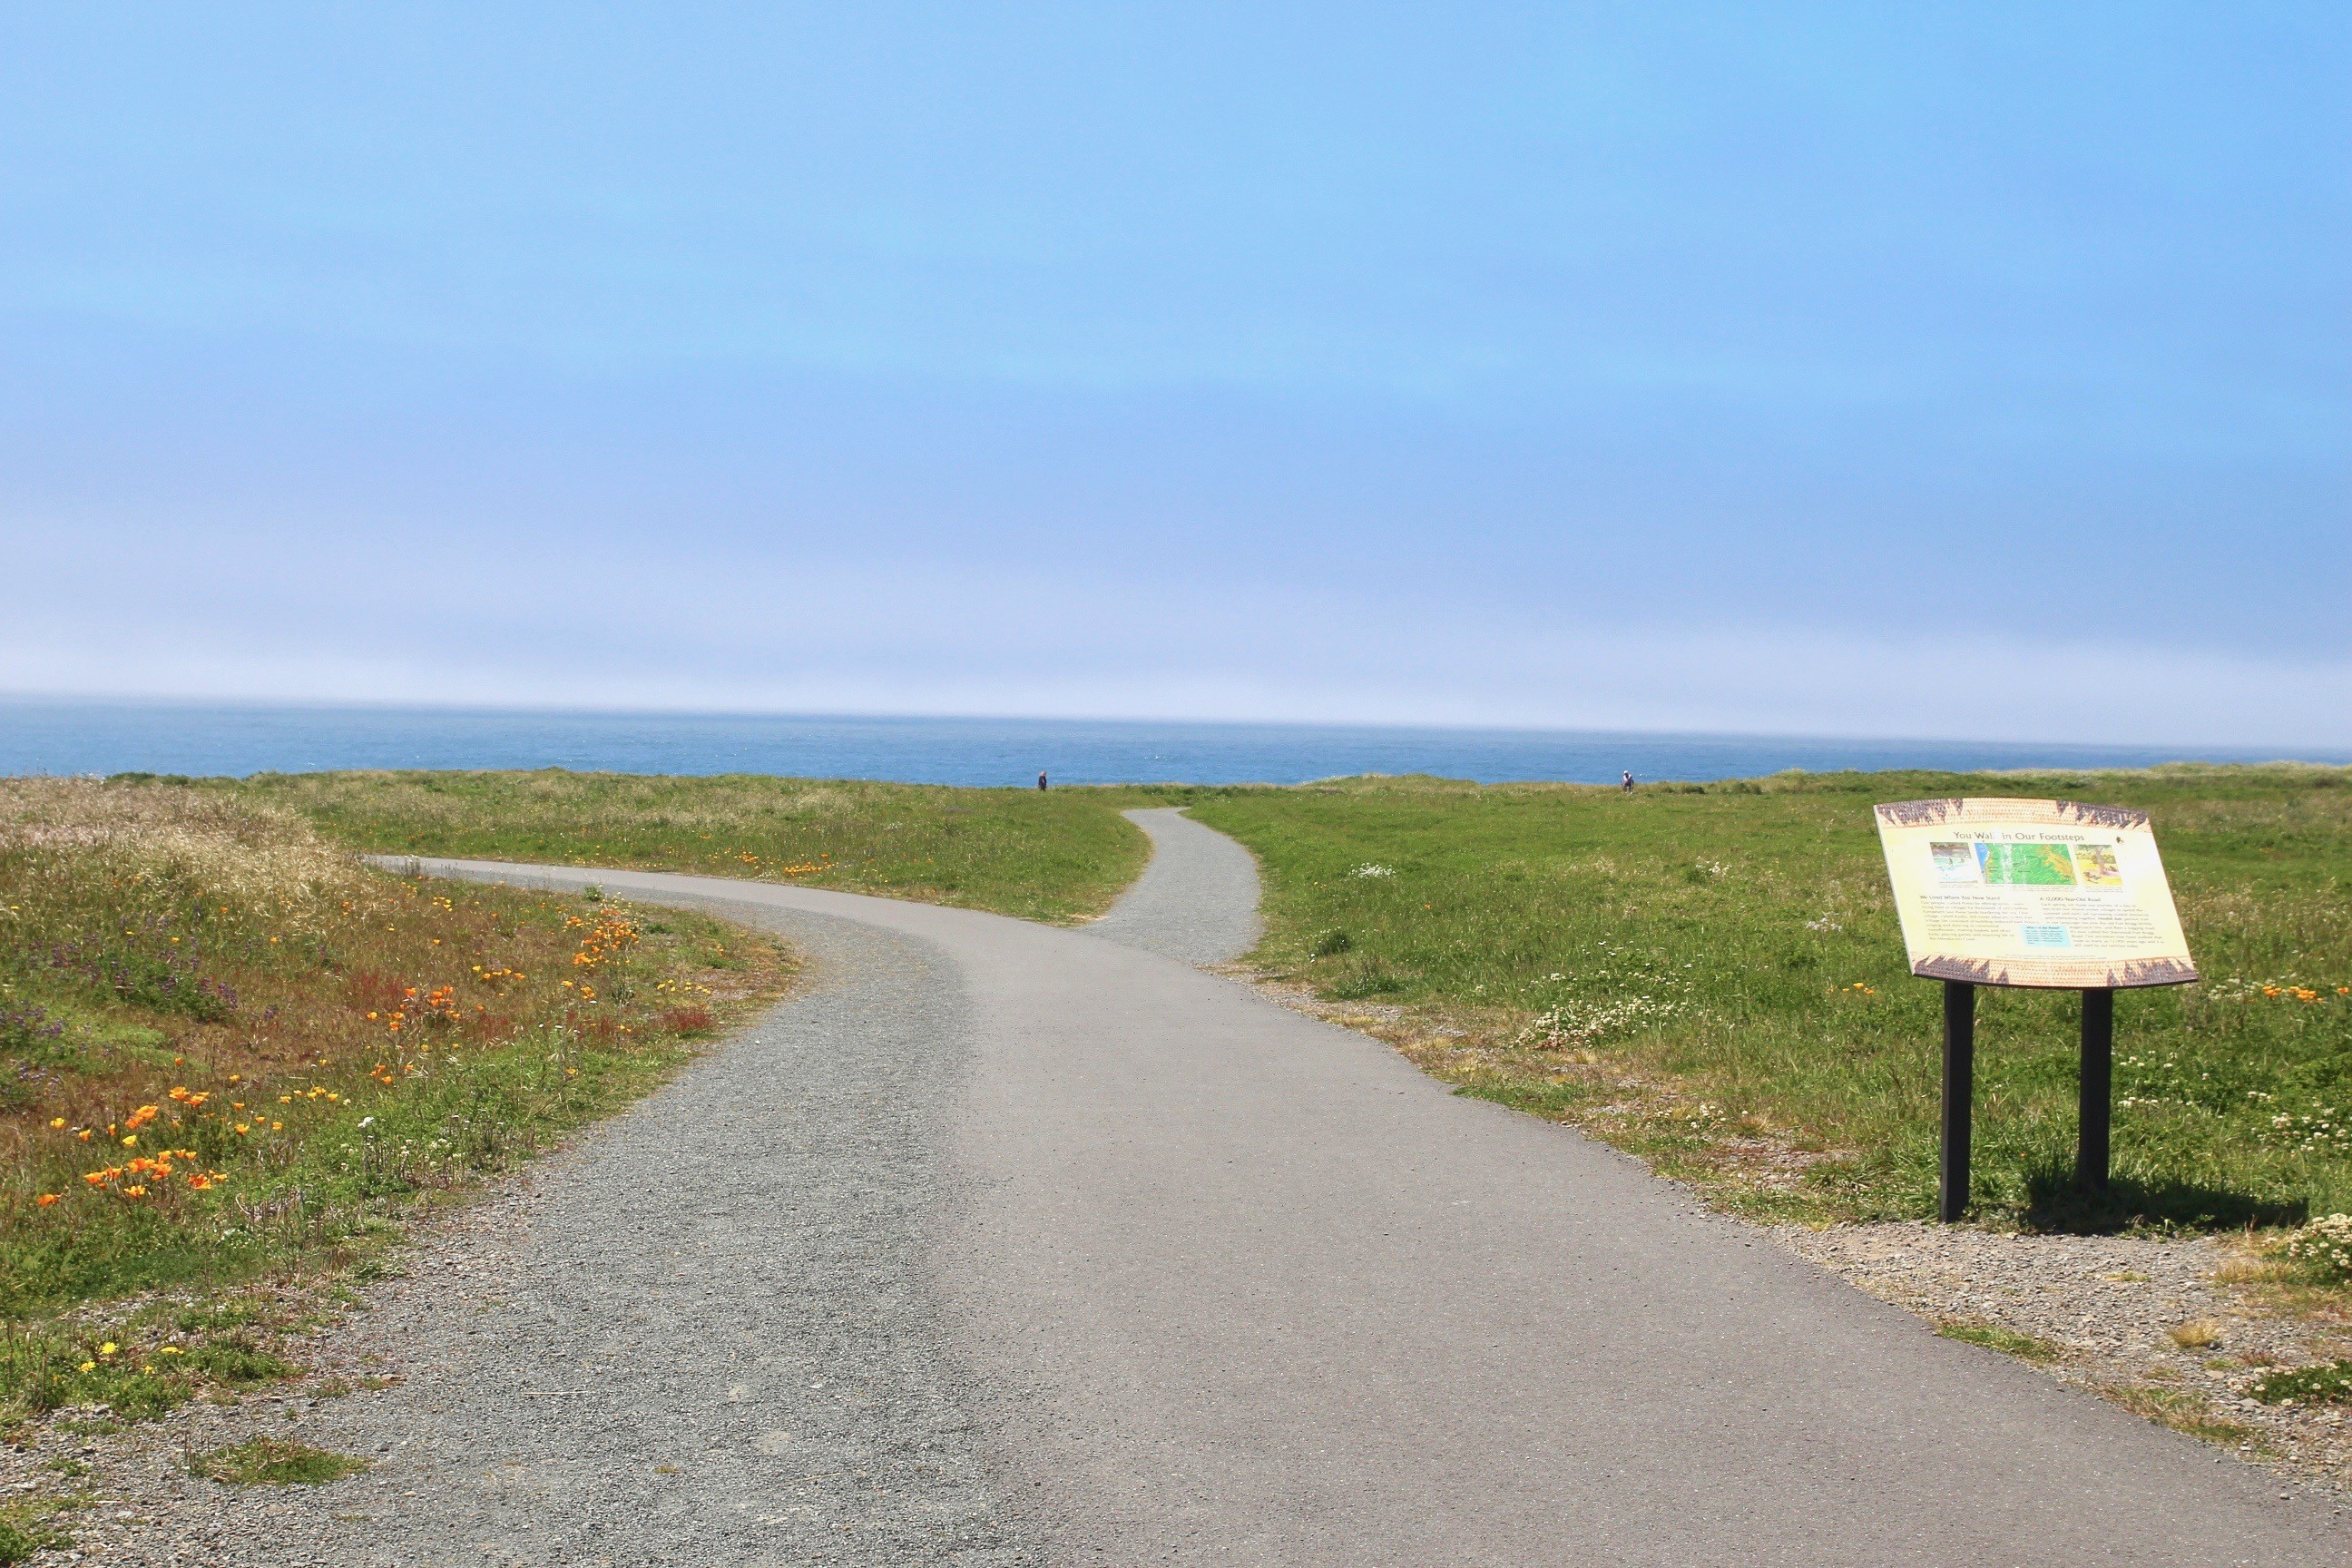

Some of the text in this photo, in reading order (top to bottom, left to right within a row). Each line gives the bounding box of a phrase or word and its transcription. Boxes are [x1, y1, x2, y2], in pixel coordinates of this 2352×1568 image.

[1953, 831, 2085, 842] You Wal in Our Footsteps
